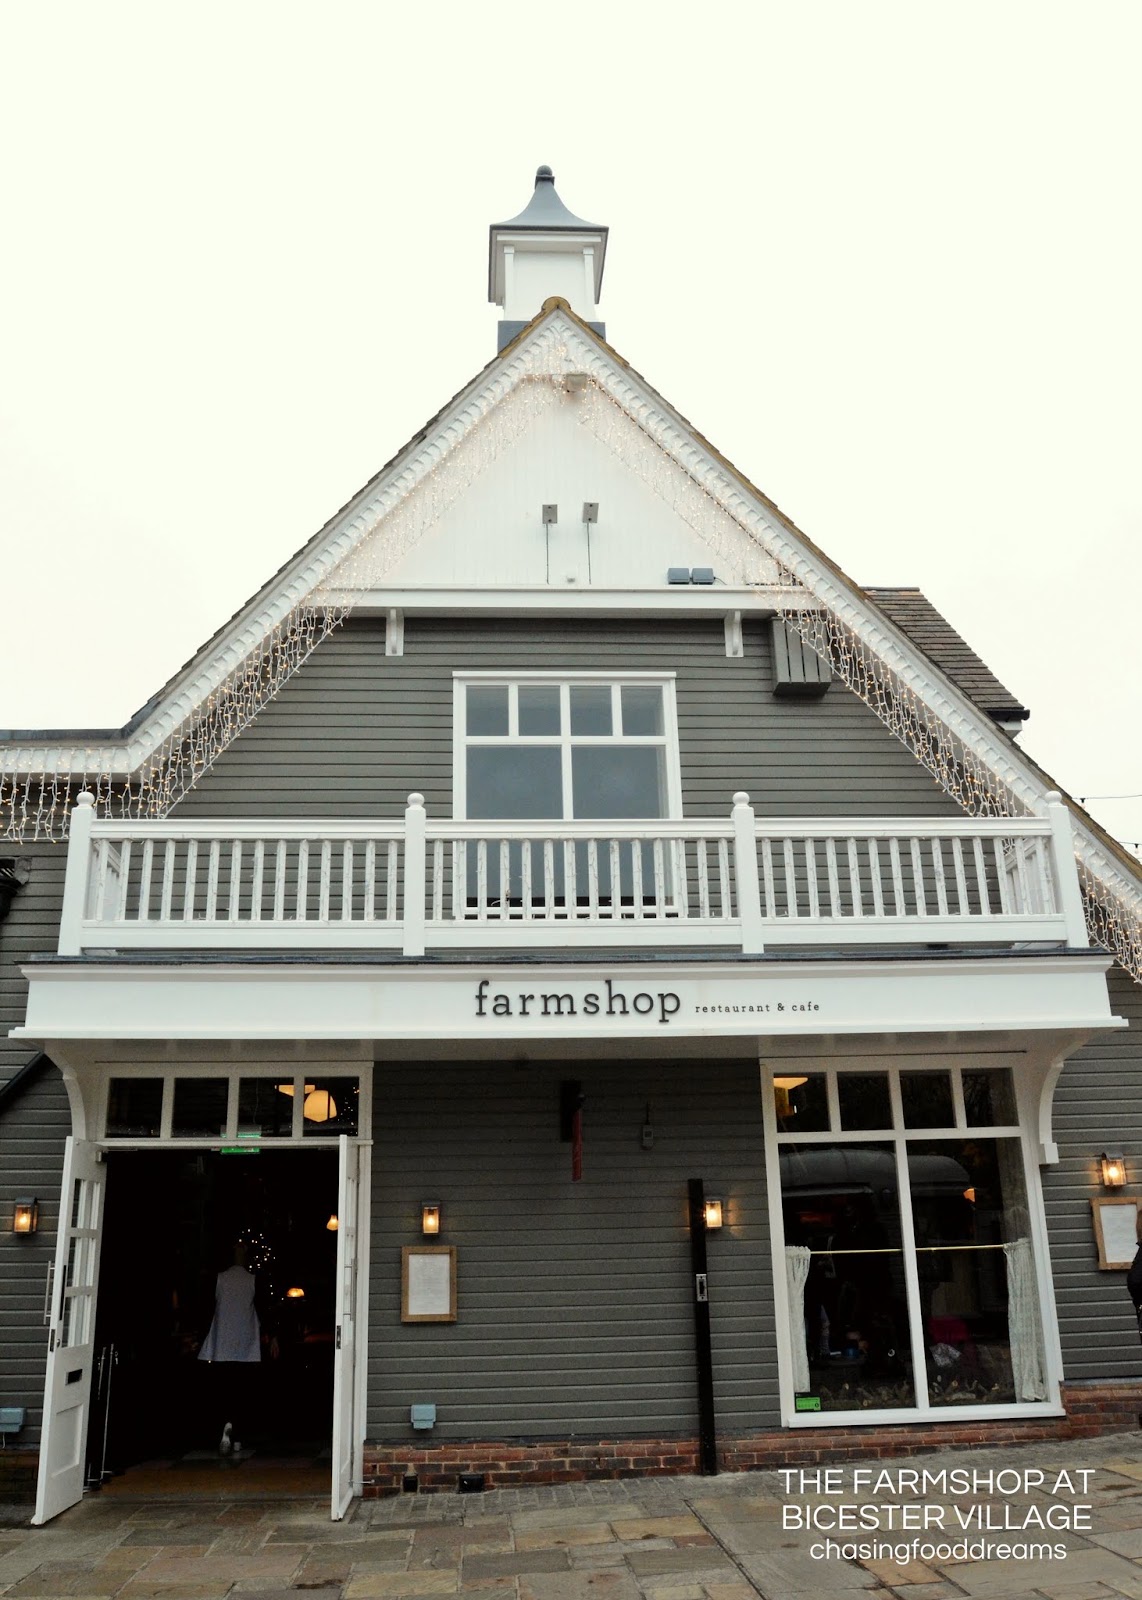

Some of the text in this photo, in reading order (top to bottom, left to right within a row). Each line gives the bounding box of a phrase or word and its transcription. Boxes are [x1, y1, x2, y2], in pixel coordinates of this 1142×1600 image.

[475, 980, 820, 1023] farmshop restaurant & cafe
